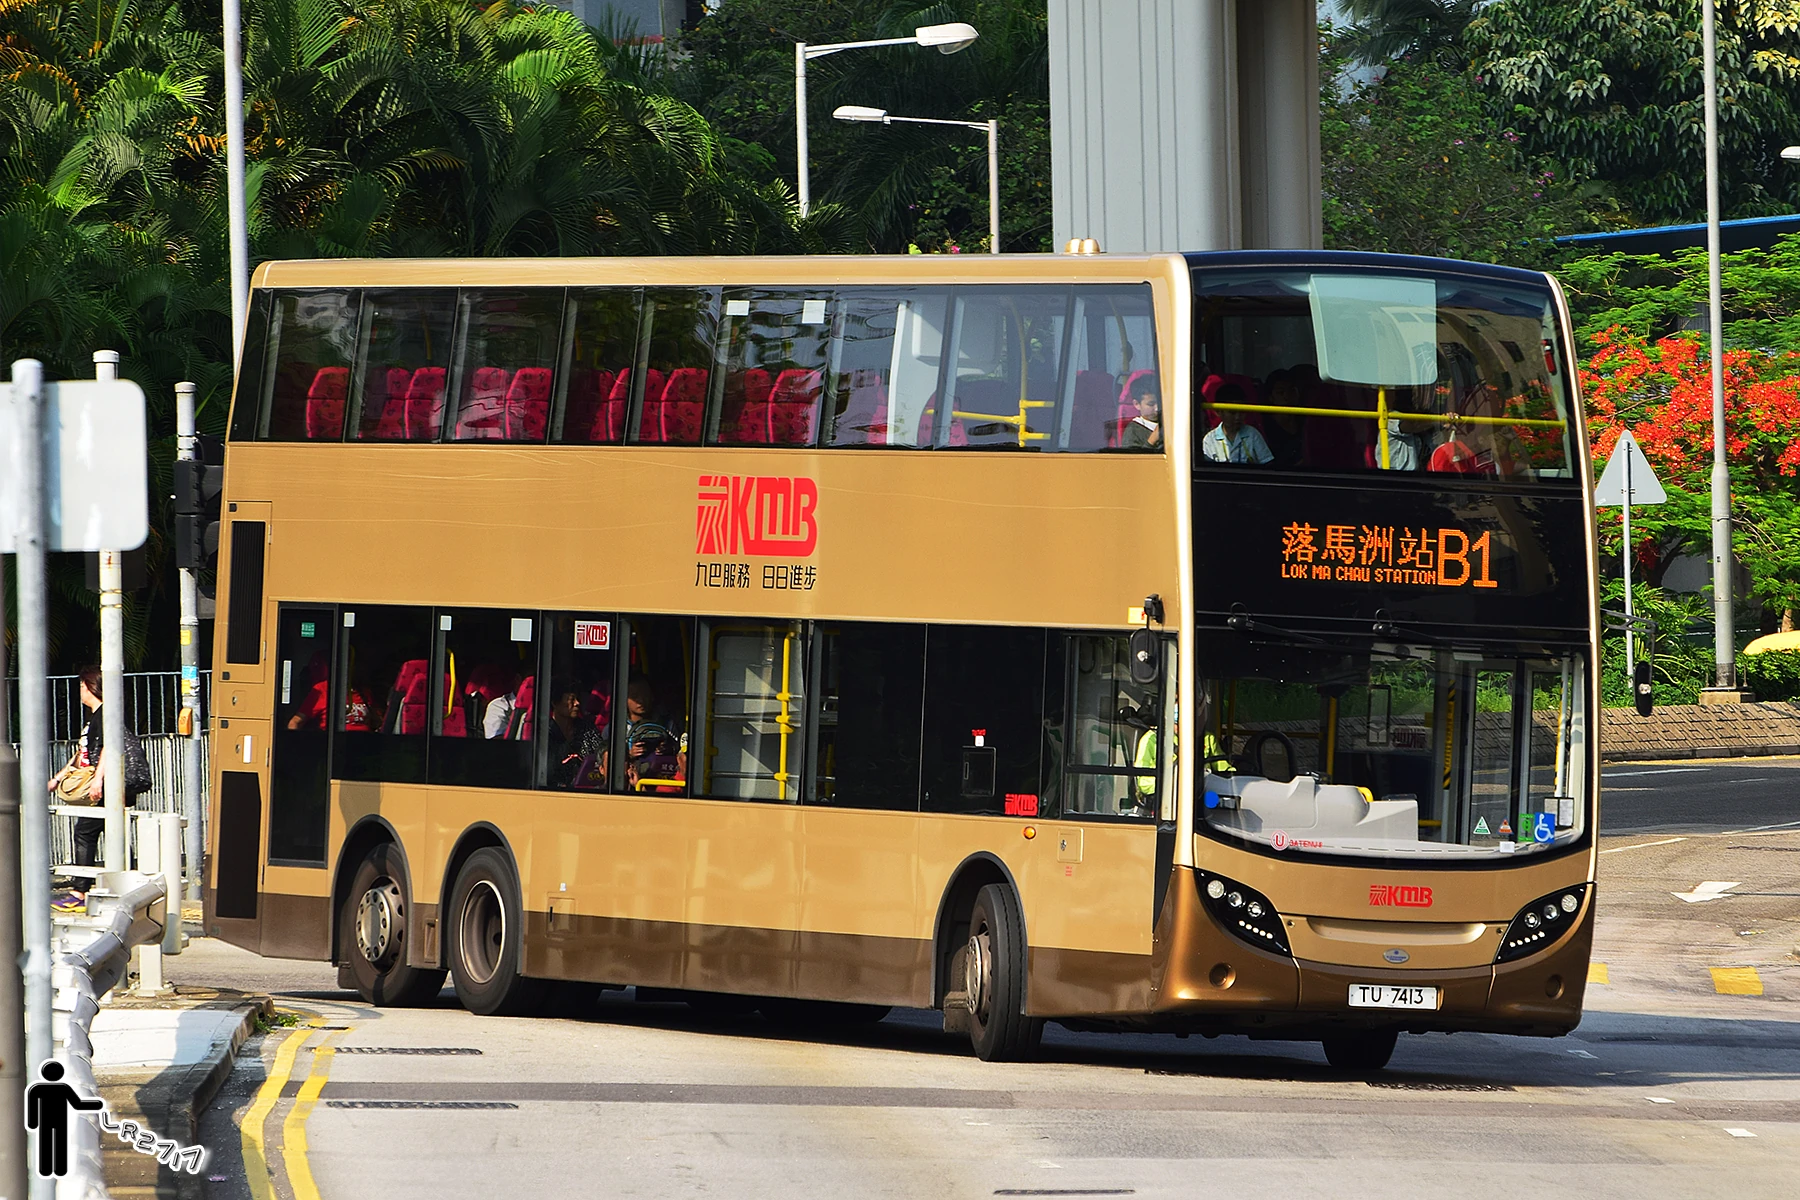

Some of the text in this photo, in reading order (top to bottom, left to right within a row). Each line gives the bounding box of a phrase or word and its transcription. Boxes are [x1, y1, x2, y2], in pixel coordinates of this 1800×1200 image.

[1281, 521, 1438, 568] 落馬洲站
[1437, 528, 1498, 588] B1
[695, 562, 817, 590] 九巴服務 日日進步
[1281, 563, 1437, 585] LOK MA CHAU STATION
[1359, 986, 1424, 1004] TU 7413
